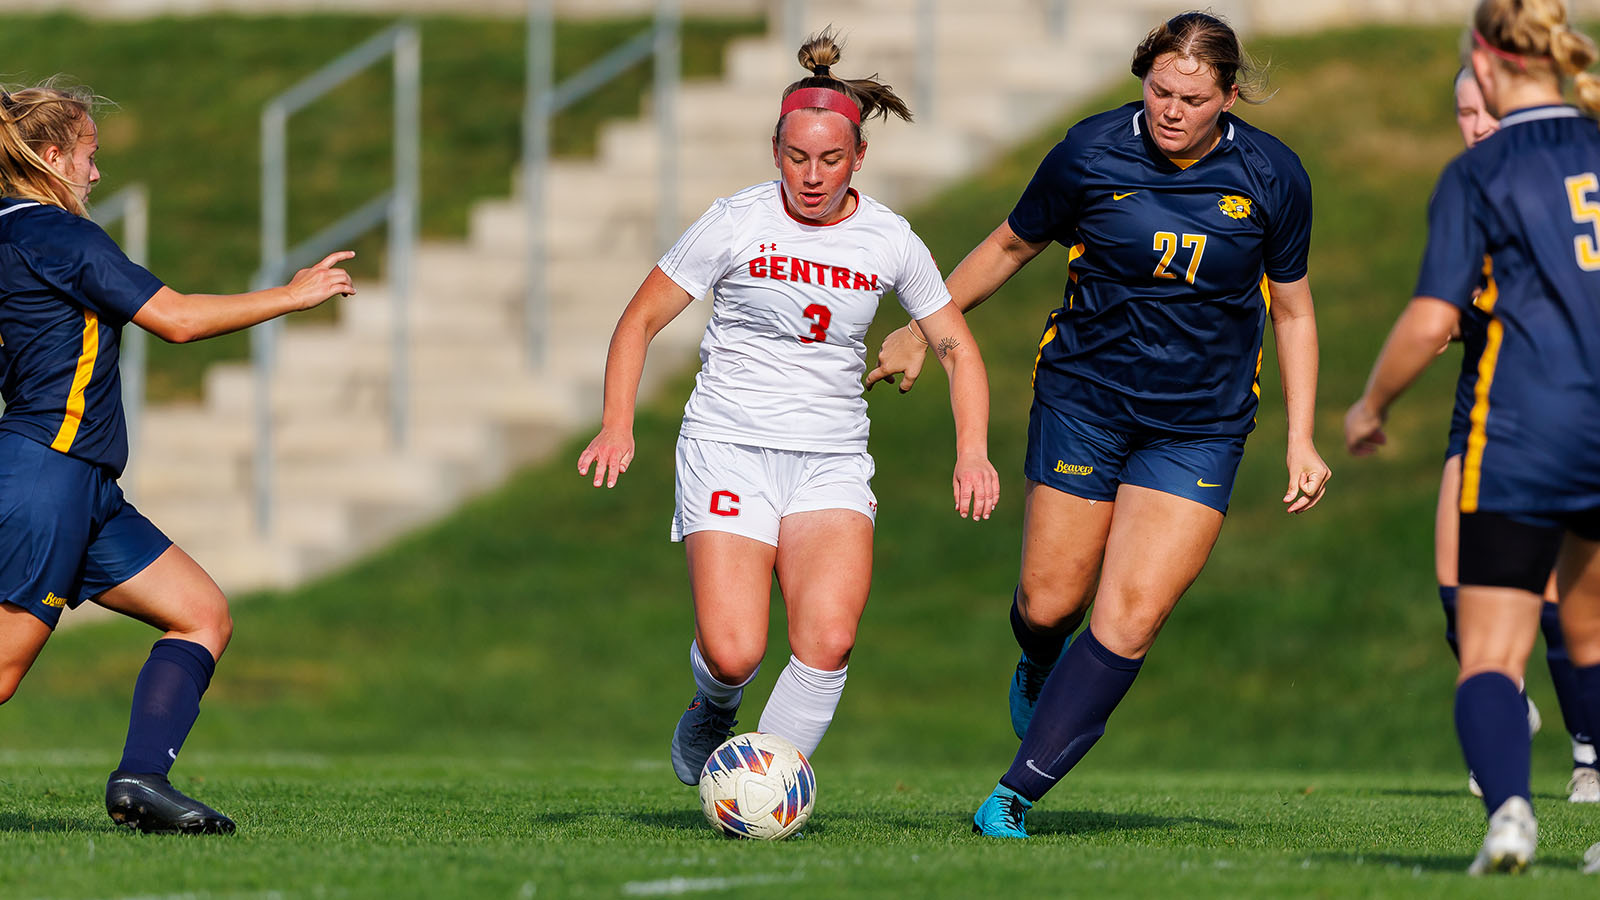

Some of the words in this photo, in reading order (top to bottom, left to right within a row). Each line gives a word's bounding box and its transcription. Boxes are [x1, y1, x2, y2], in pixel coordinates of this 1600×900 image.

[1153, 231, 1207, 284] 27
[802, 303, 832, 344] 3
[1053, 459, 1094, 476] Beavers
[709, 490, 740, 516] C
